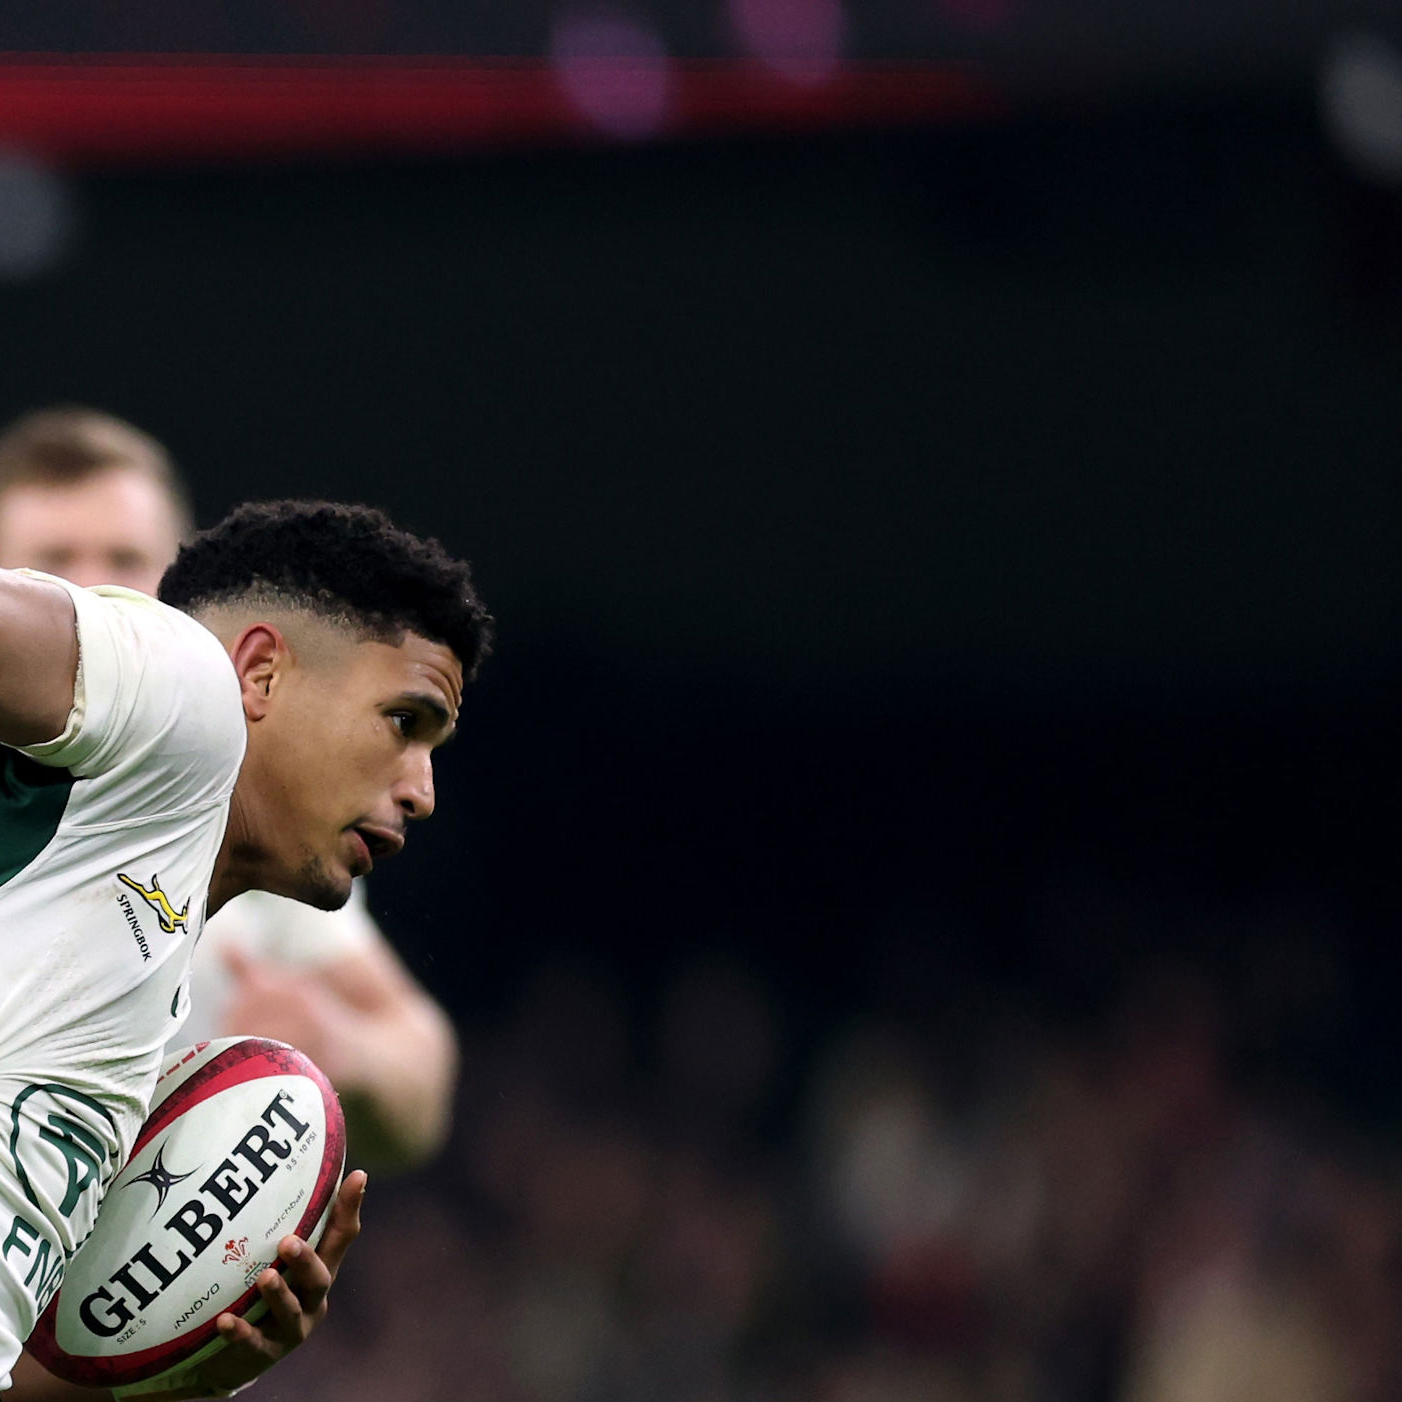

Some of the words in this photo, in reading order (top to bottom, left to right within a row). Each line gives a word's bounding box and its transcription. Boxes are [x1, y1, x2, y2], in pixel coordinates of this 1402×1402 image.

[116, 893, 152, 962] SPRINGBOK
[79, 1091, 309, 1337] GILBERT
[116, 1327, 137, 1345] SIZE
